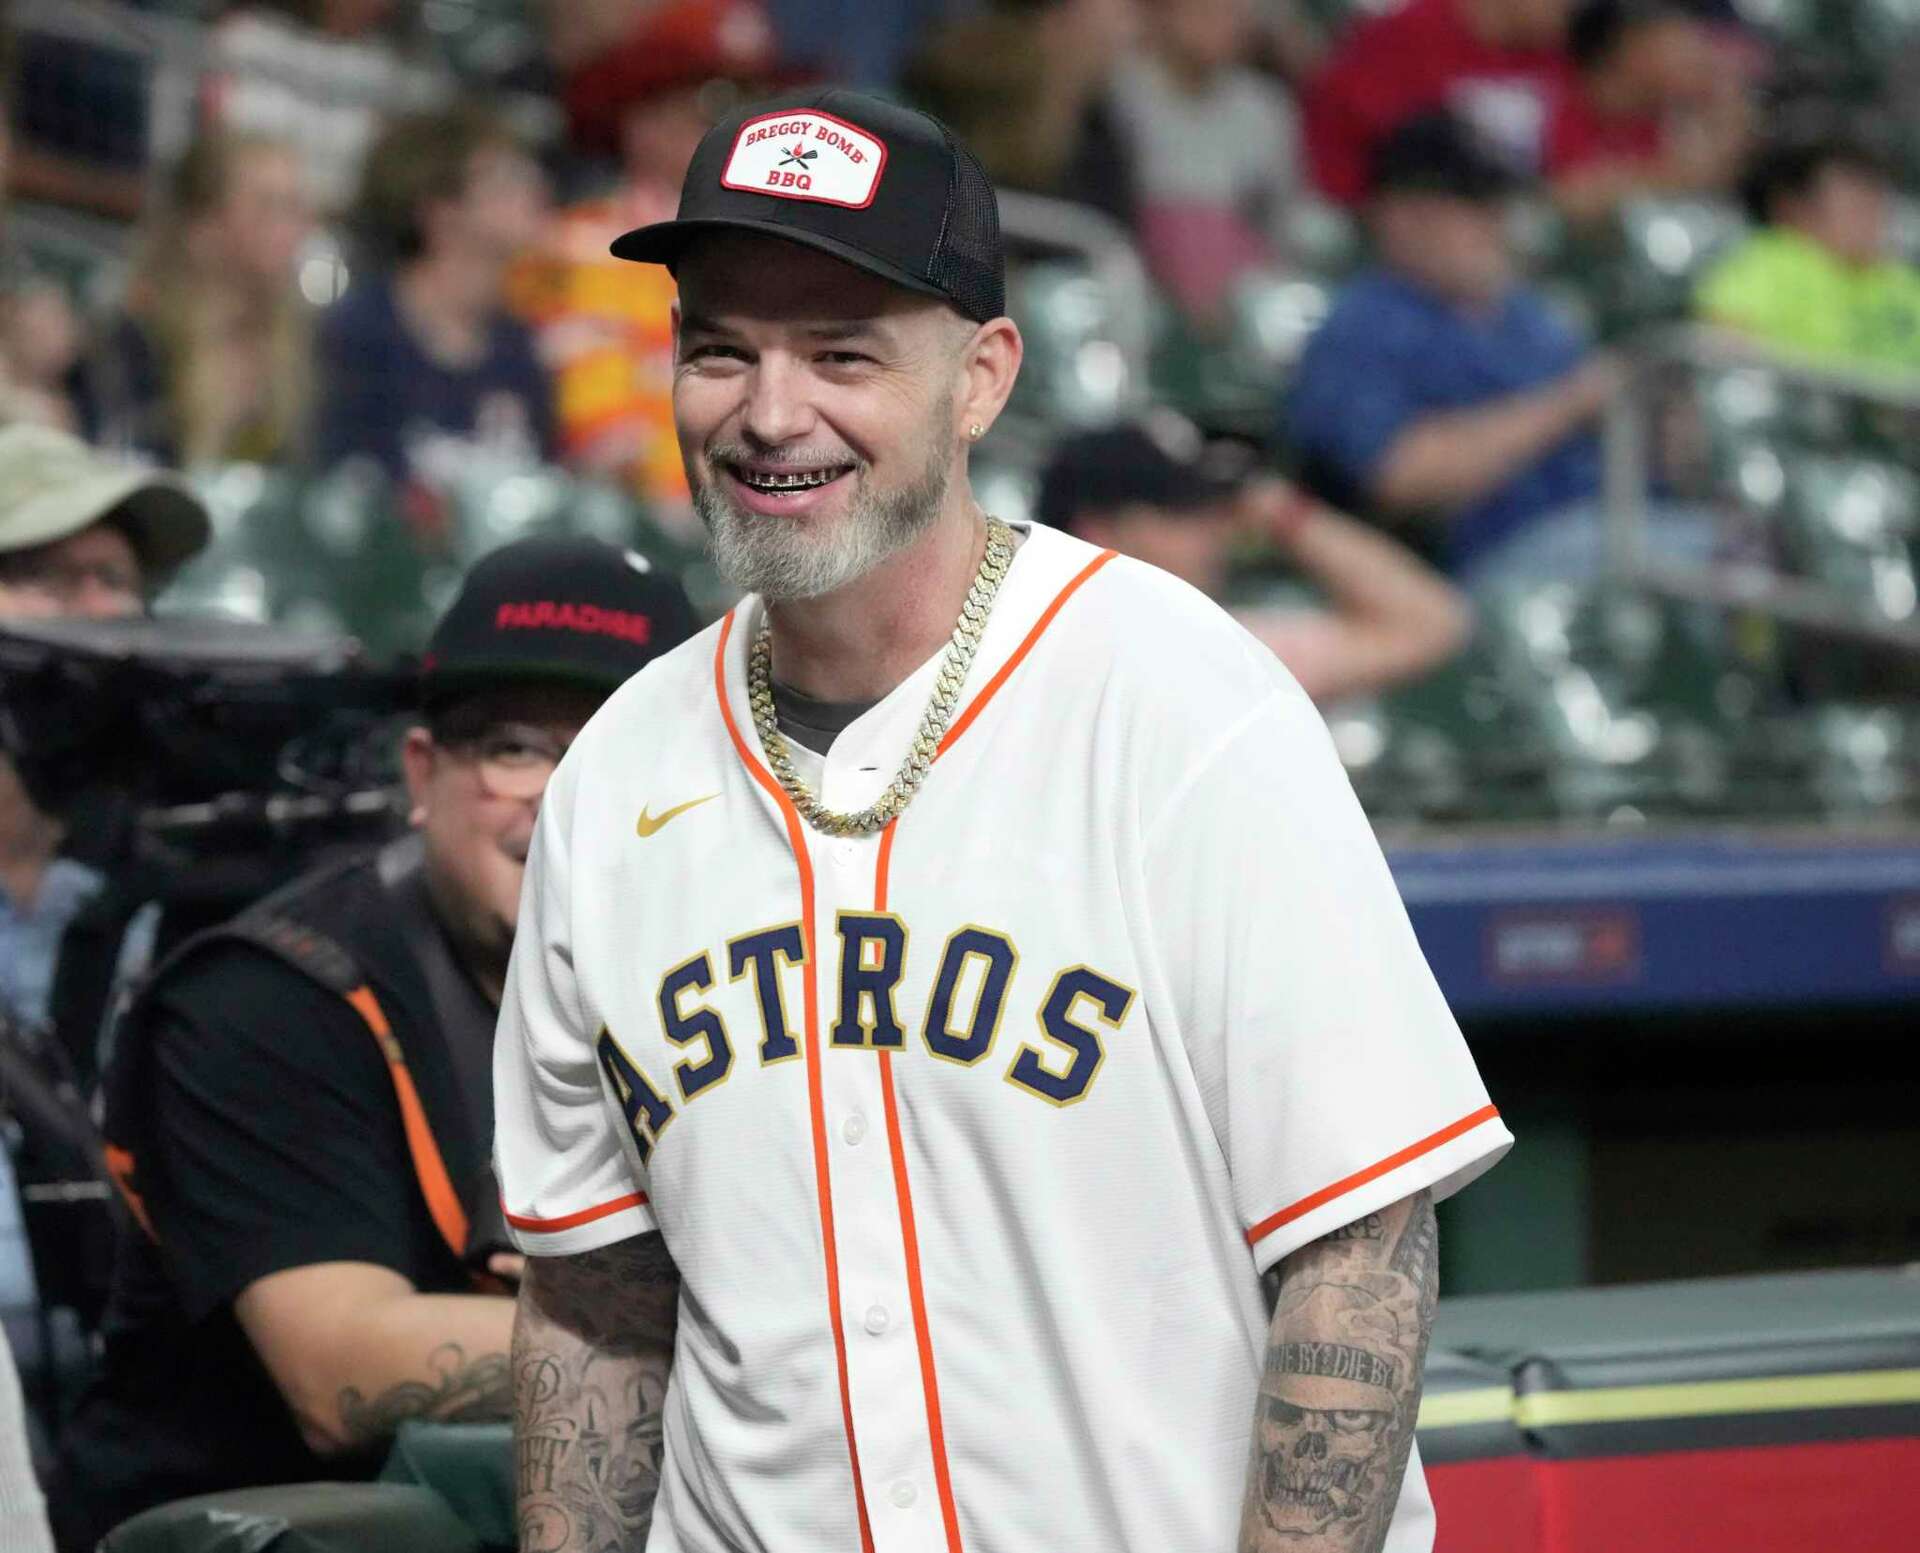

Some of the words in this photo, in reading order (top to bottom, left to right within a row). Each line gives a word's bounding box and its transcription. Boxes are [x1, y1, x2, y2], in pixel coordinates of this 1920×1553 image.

[745, 121, 812, 147] BREGGY
[766, 170, 812, 190] BBQ
[496, 601, 651, 646] PARADISE
[591, 909, 1137, 1169] ASTROS
[1299, 1343, 1321, 1374] BY
[1333, 1346, 1366, 1380] DIE
[1371, 1357, 1393, 1387] BY
